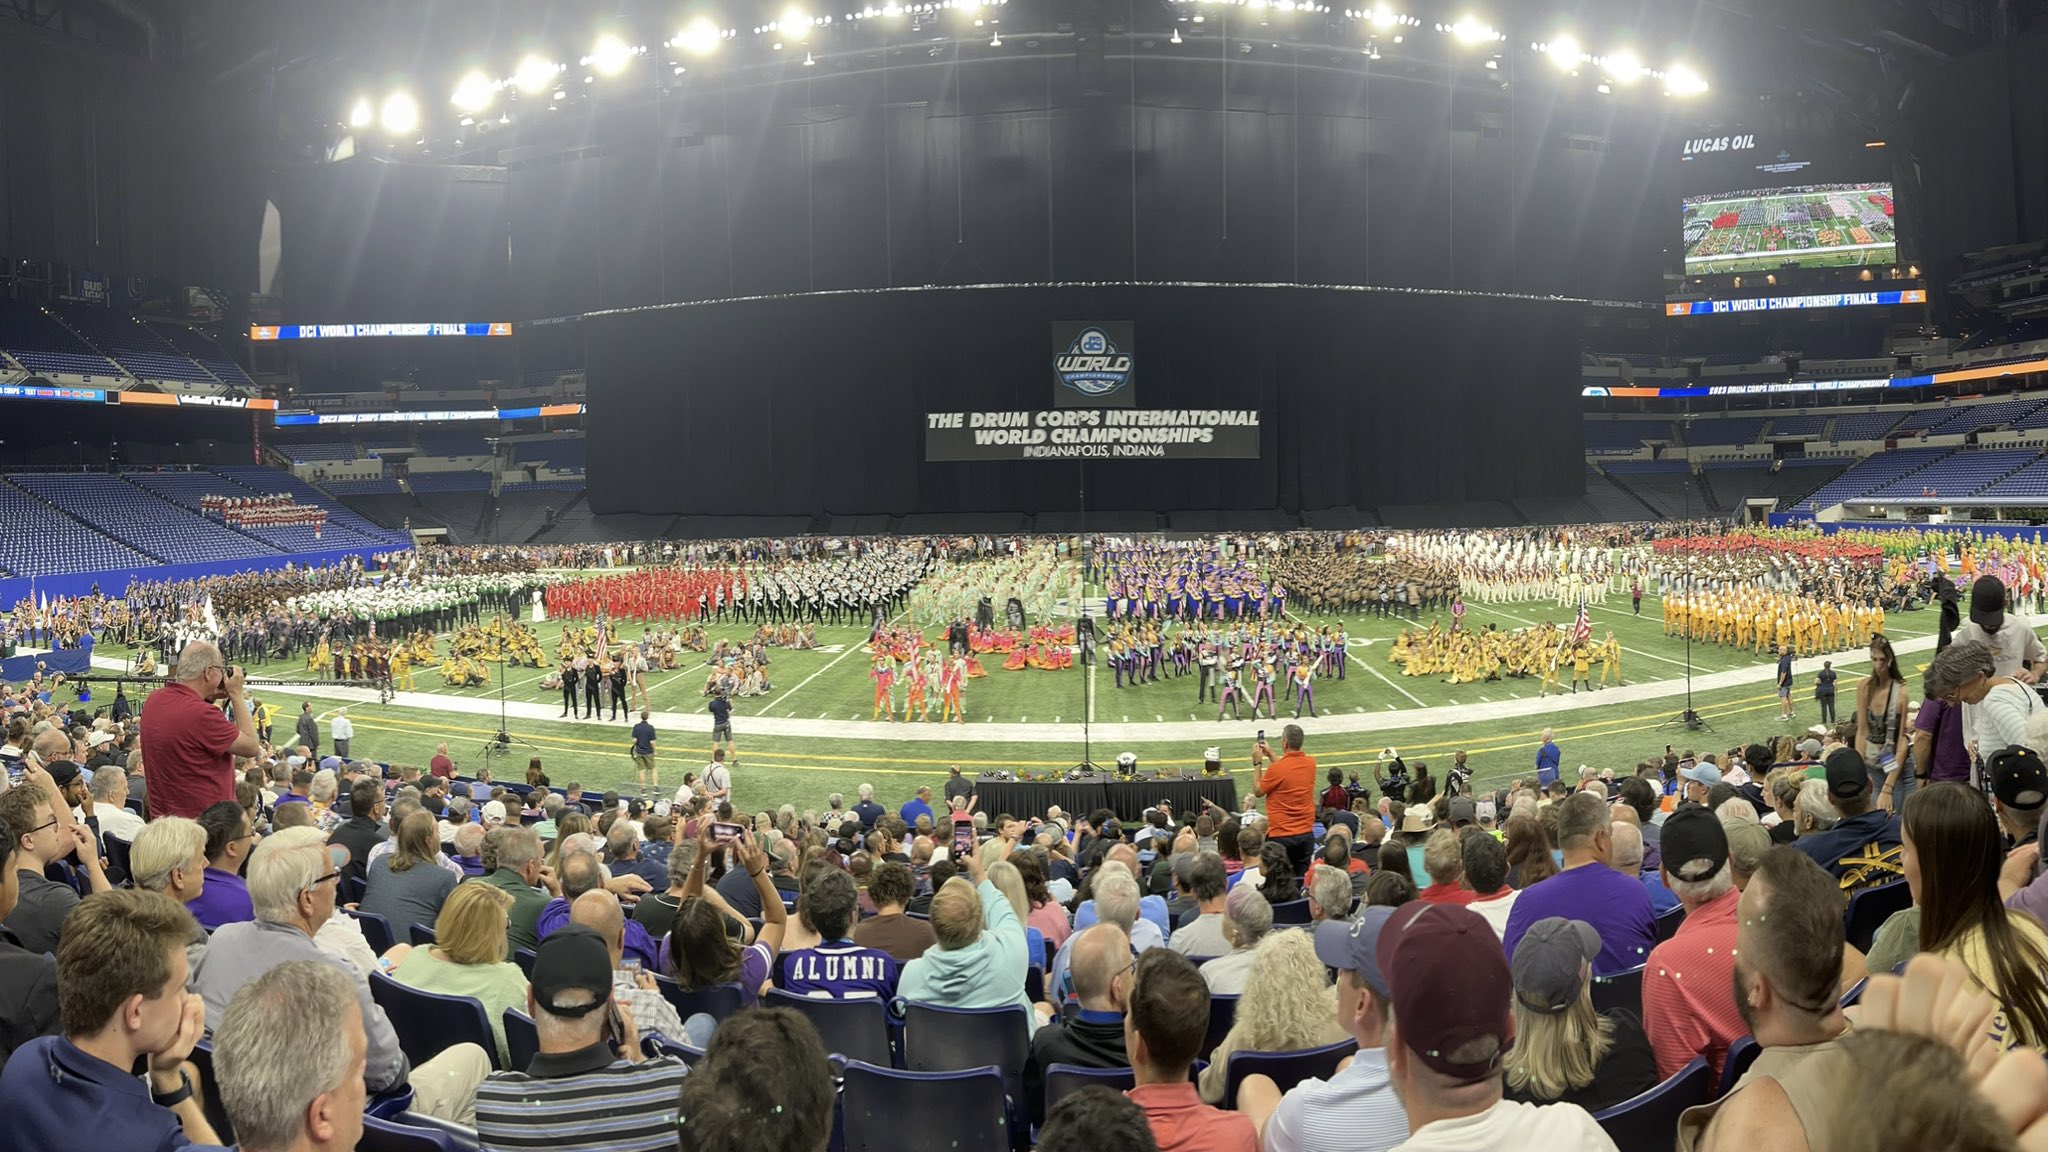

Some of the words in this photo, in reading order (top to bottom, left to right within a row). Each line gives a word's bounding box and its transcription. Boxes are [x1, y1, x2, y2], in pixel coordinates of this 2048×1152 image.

[1683, 136, 1730, 154] LUCAS
[1731, 134, 1755, 150] OIL
[83, 280, 103, 291] BUD
[1712, 301, 1729, 313] DCI
[1732, 299, 1767, 311] WORLD
[1769, 294, 1841, 309] CHAMPIONSHIP
[1844, 292, 1878, 305] FINALS
[299, 325, 317, 338] DCI
[319, 324, 355, 337] WORLD
[357, 323, 431, 337] CHAMPIONSHIP
[433, 323, 467, 336] FINALS
[1057, 356, 1131, 371] WORLD
[1747, 385, 1768, 393] CORPS
[928, 413, 964, 429] THE
[969, 411, 1029, 428] DRUM
[1035, 410, 1100, 427] CORPS
[1105, 409, 1259, 426] INTERNATIONAL
[974, 429, 1047, 445] WORLD
[1050, 427, 1214, 444] CHAMPIONSHIPS
[1113, 444, 1165, 457] INDIANA
[793, 956, 885, 980] ALUMNI
